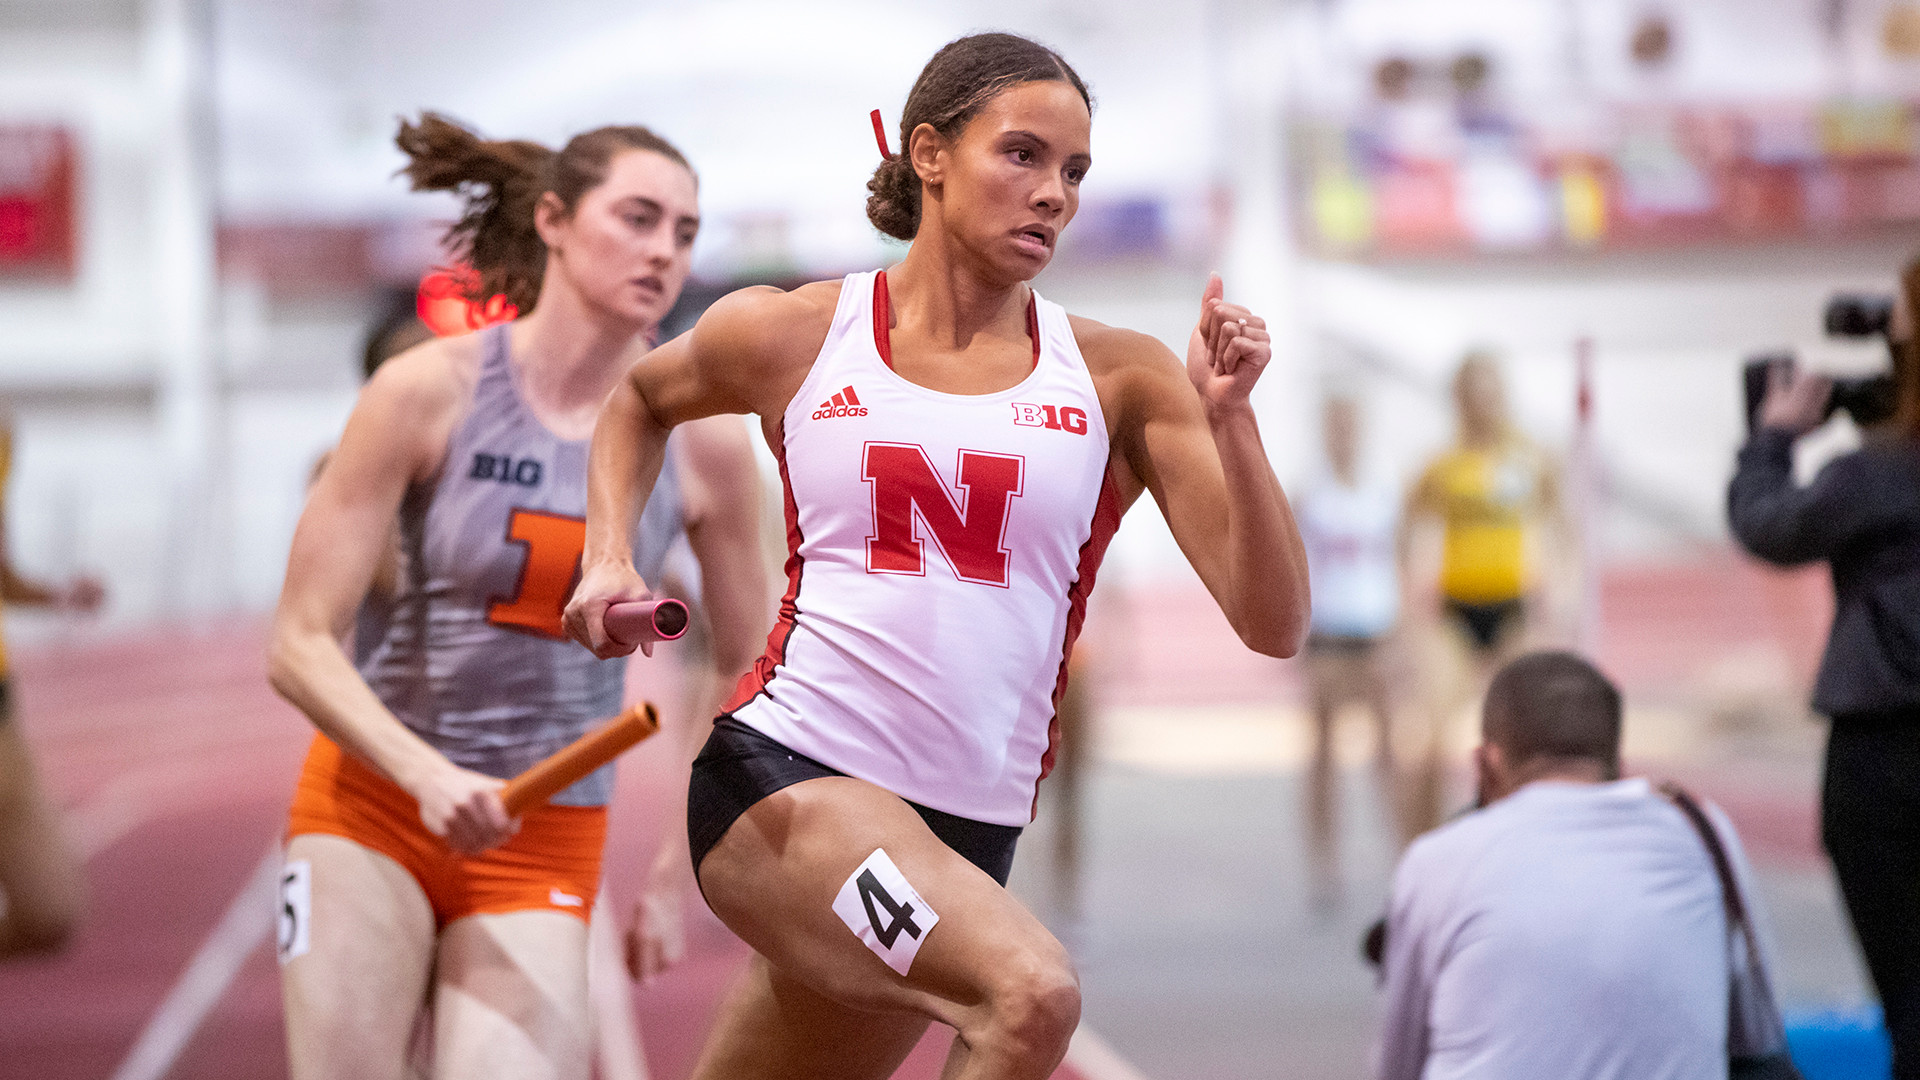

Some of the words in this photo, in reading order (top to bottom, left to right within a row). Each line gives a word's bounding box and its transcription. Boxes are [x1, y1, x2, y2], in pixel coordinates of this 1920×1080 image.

[812, 404, 868, 420] adidas
[861, 441, 1025, 588] N
[856, 867, 922, 951] 4
